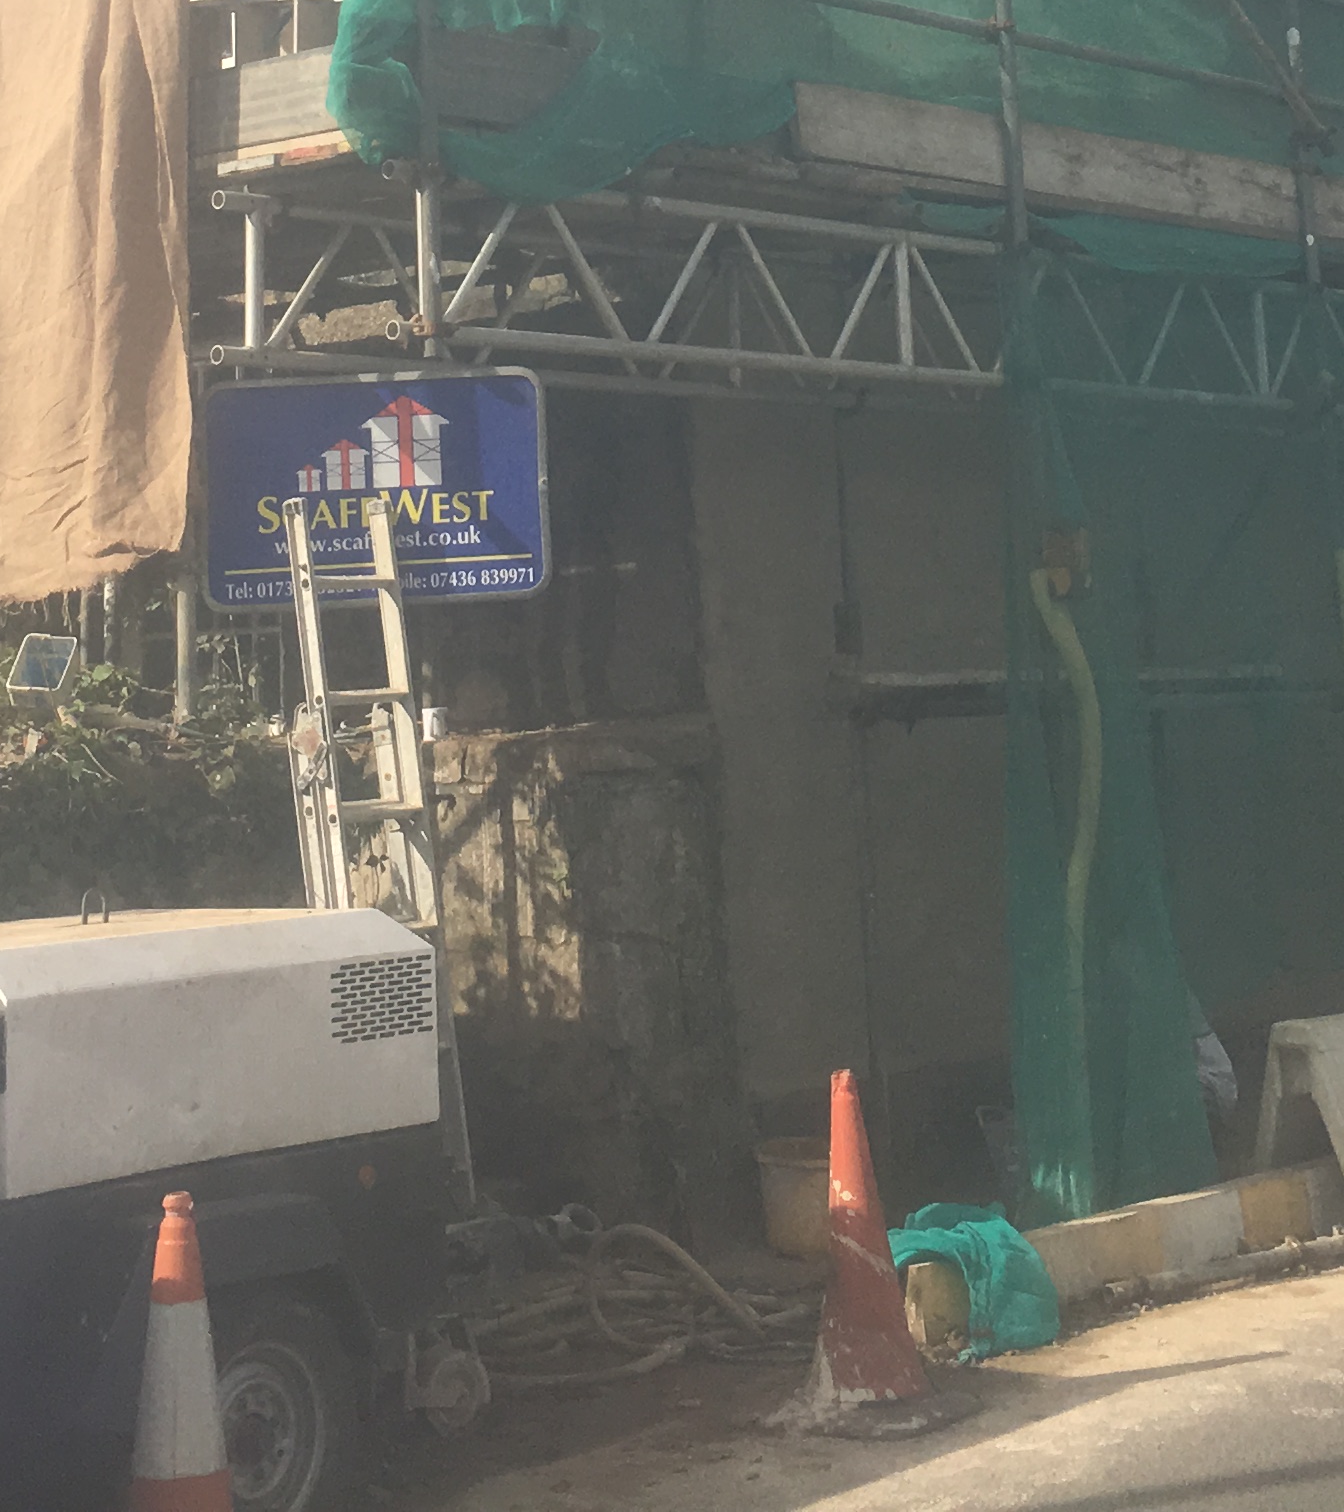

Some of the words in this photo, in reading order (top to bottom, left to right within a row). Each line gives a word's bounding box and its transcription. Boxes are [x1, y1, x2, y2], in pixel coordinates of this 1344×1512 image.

[225, 582, 253, 600] Tel:
[430, 569, 477, 588] 07436
[481, 567, 534, 585] 839971
